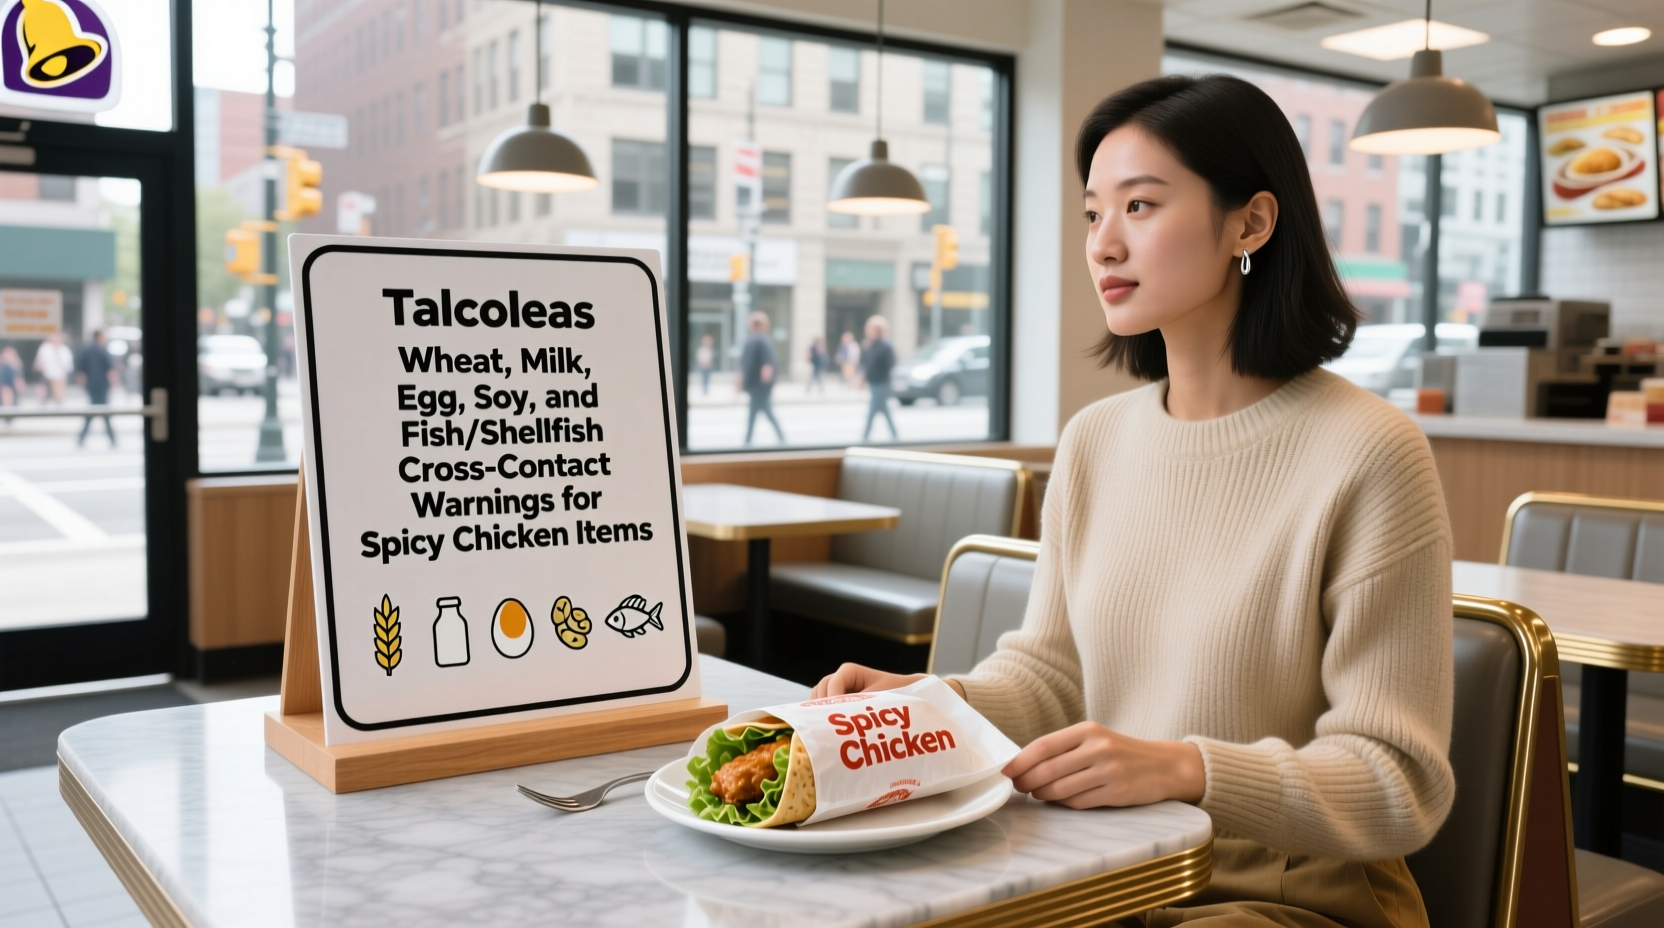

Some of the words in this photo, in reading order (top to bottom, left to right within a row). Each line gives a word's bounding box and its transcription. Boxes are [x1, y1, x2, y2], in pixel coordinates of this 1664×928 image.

[383, 288, 595, 329] Talcoleas
[398, 346, 511, 379] Wheat,
[521, 347, 590, 379] Milk,
[398, 384, 465, 417] Egg,
[474, 384, 535, 416] Soy,
[546, 383, 598, 408] and
[402, 417, 603, 451] Fish/Shellfish
[399, 453, 611, 483] Cross-Contact
[411, 488, 555, 520] Warnings
[562, 485, 602, 511] for
[361, 528, 445, 564] Spicy
[453, 523, 568, 552] Chicken
[577, 520, 653, 544] Items
[828, 705, 911, 737] Spicy
[840, 730, 956, 770] Chicken
